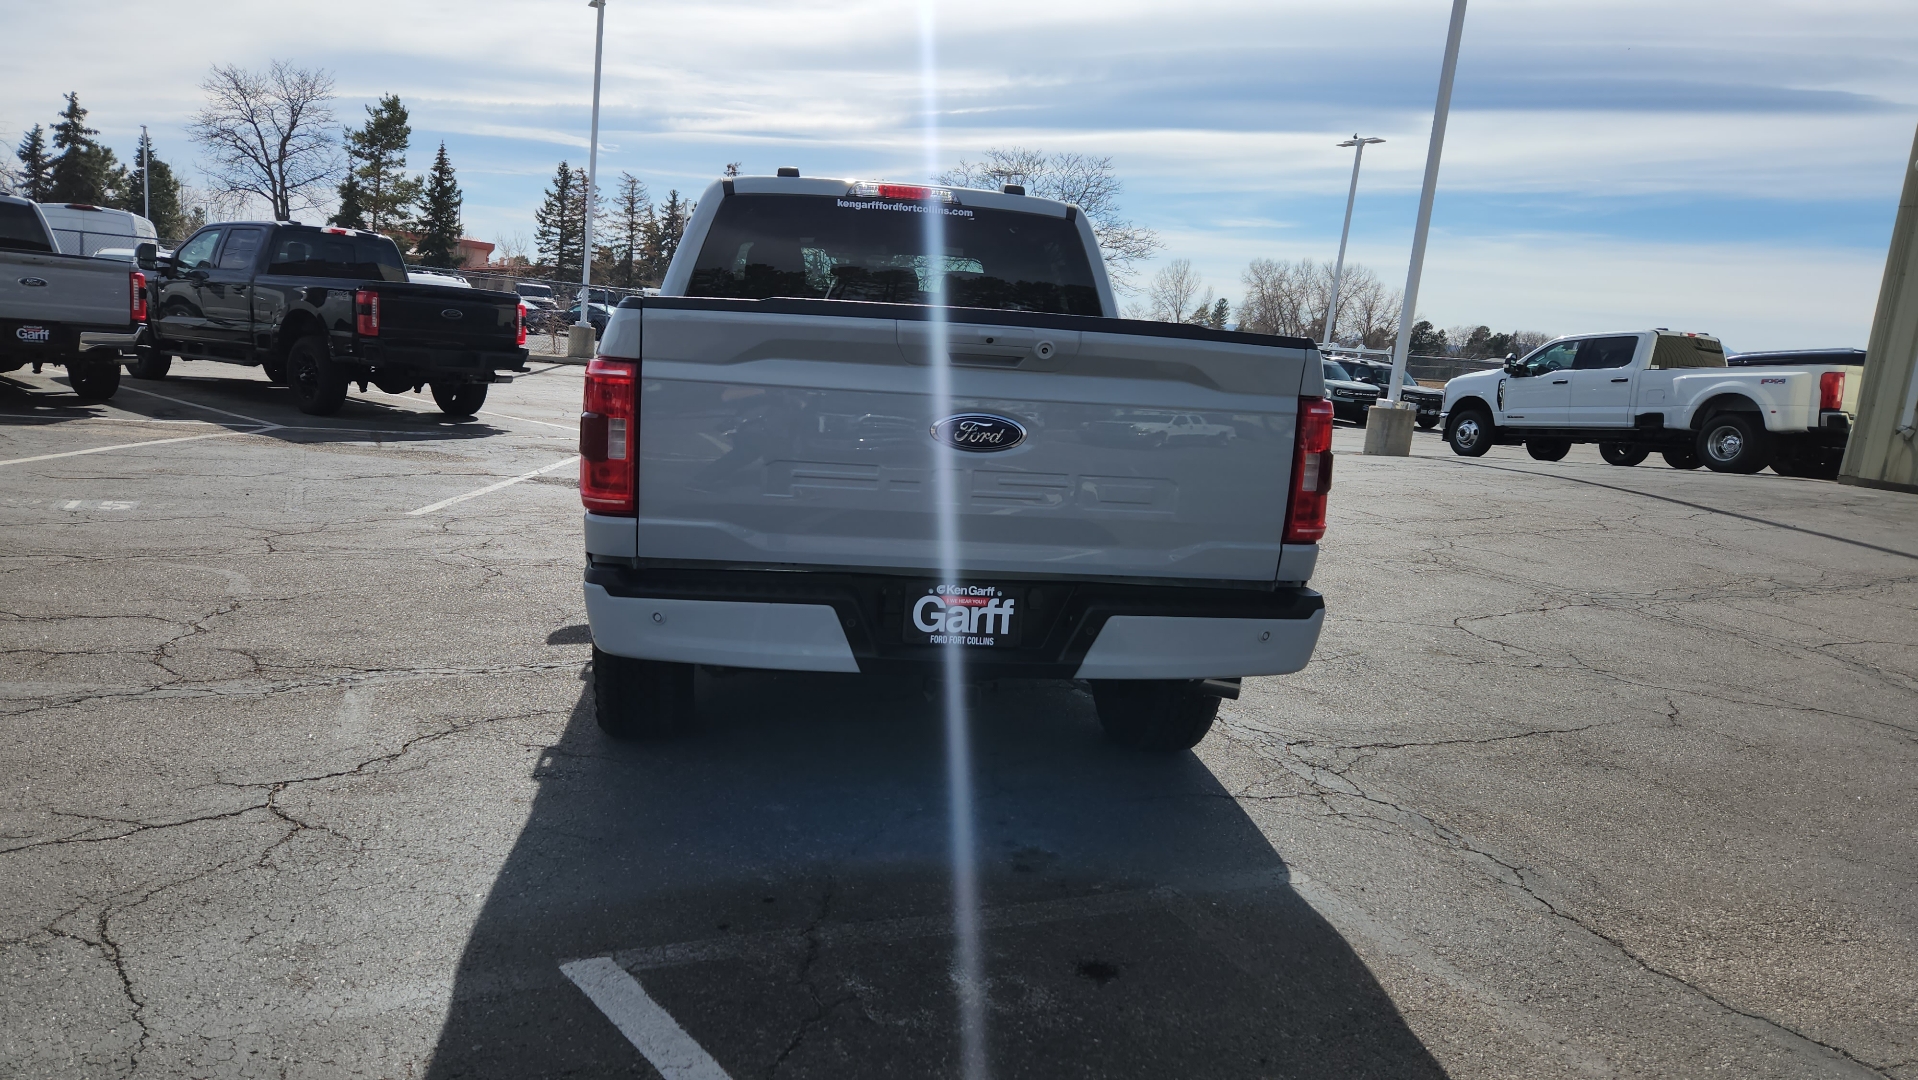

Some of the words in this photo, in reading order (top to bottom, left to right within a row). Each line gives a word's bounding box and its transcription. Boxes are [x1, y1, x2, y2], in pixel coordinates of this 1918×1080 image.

[16, 327, 50, 340] Garff
[946, 584, 967, 596] Ken
[968, 585, 995, 597] Garff
[912, 595, 1015, 635] Garff
[930, 634, 948, 644] FORD
[948, 635, 966, 645] FORT
[967, 636, 994, 646] COLLINS
